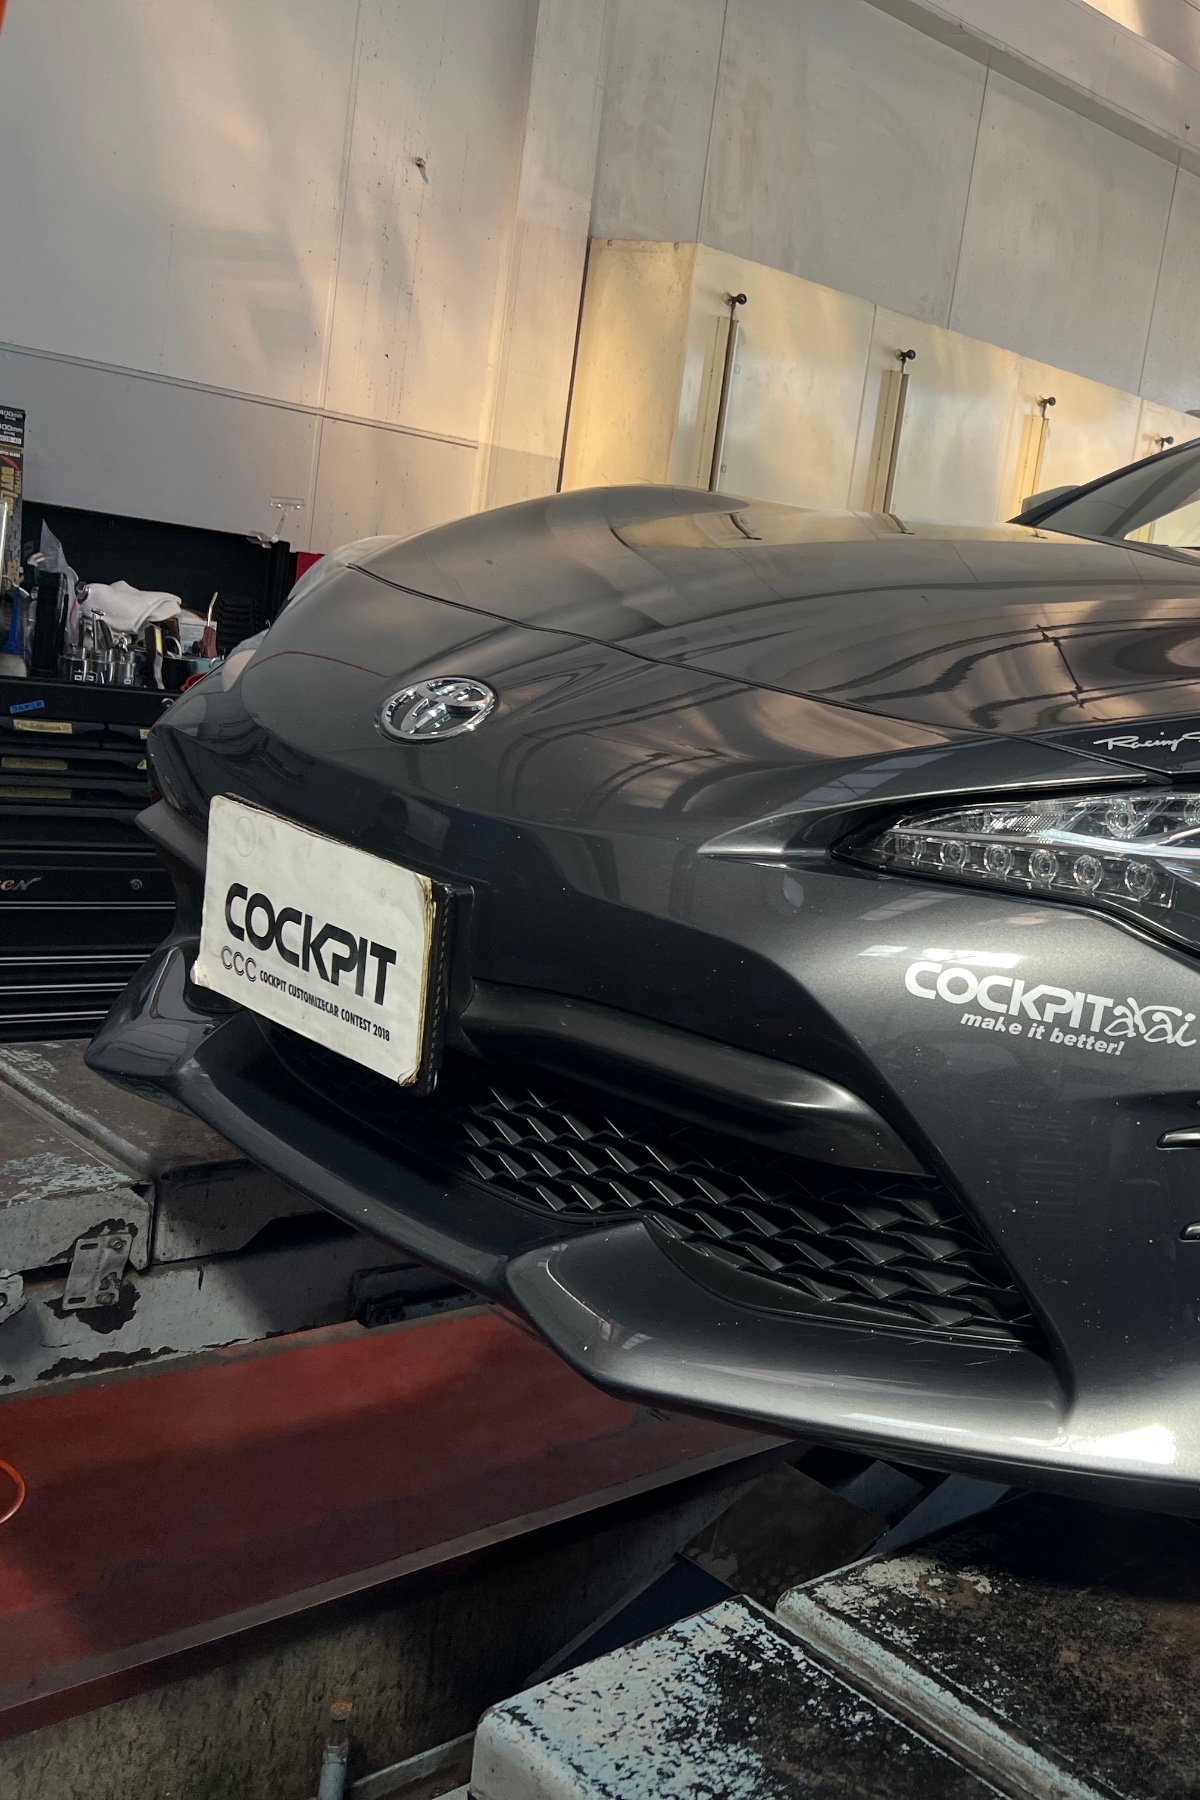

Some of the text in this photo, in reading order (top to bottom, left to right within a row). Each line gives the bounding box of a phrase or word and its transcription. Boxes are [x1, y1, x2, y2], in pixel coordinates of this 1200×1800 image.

[1093, 731, 1184, 751] Racing
[224, 882, 397, 1006] COCKPIT
[220, 945, 390, 1042] CCC COCKPIT CUSTOMIZECAR CONTEST 2018
[904, 961, 1114, 1033] COCKPIT
[960, 1012, 1125, 1056] make it better!
